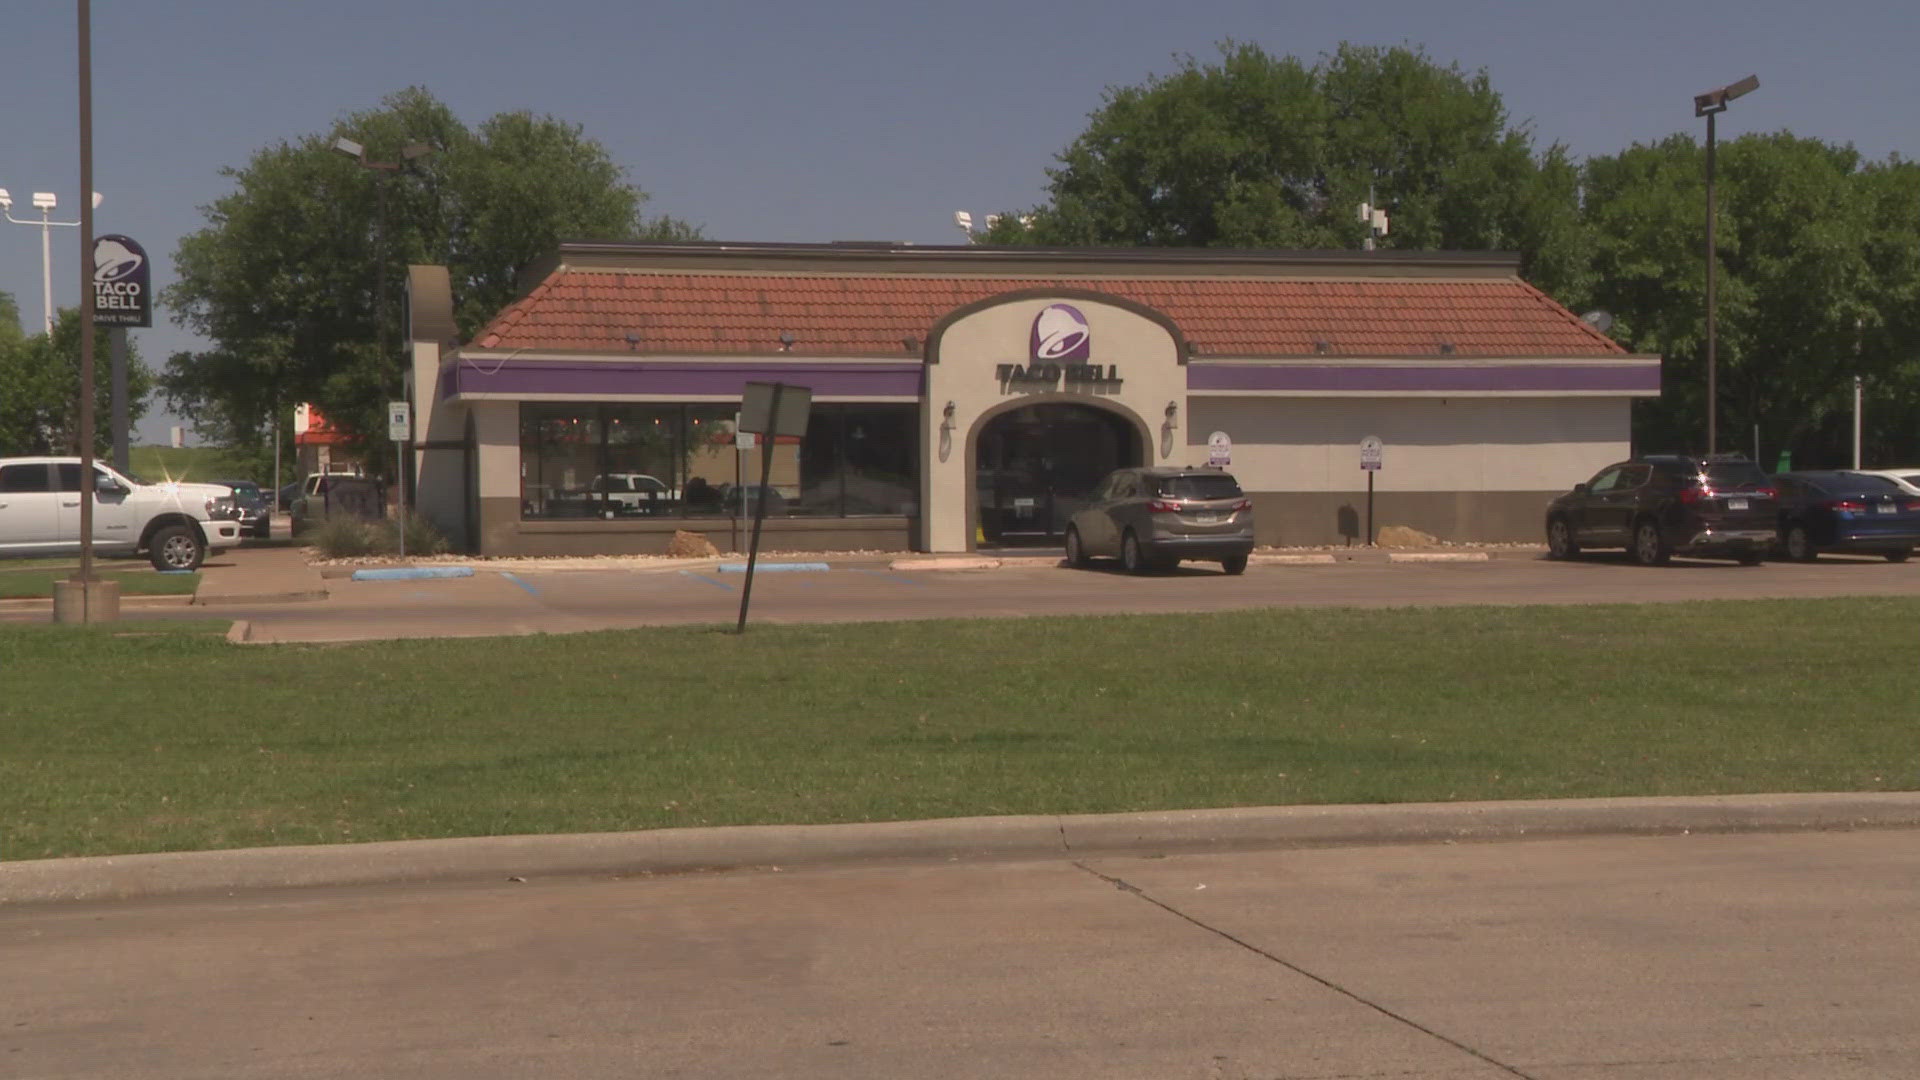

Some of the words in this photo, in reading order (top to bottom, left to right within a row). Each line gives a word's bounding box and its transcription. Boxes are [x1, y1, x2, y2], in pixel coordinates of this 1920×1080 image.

[93, 282, 140, 295] TACO
[97, 296, 140, 309] BELL
[93, 314, 117, 322] DRIVE
[118, 315, 141, 323] THRU
[996, 364, 1062, 382] TACO
[1065, 364, 1123, 384] BELL
